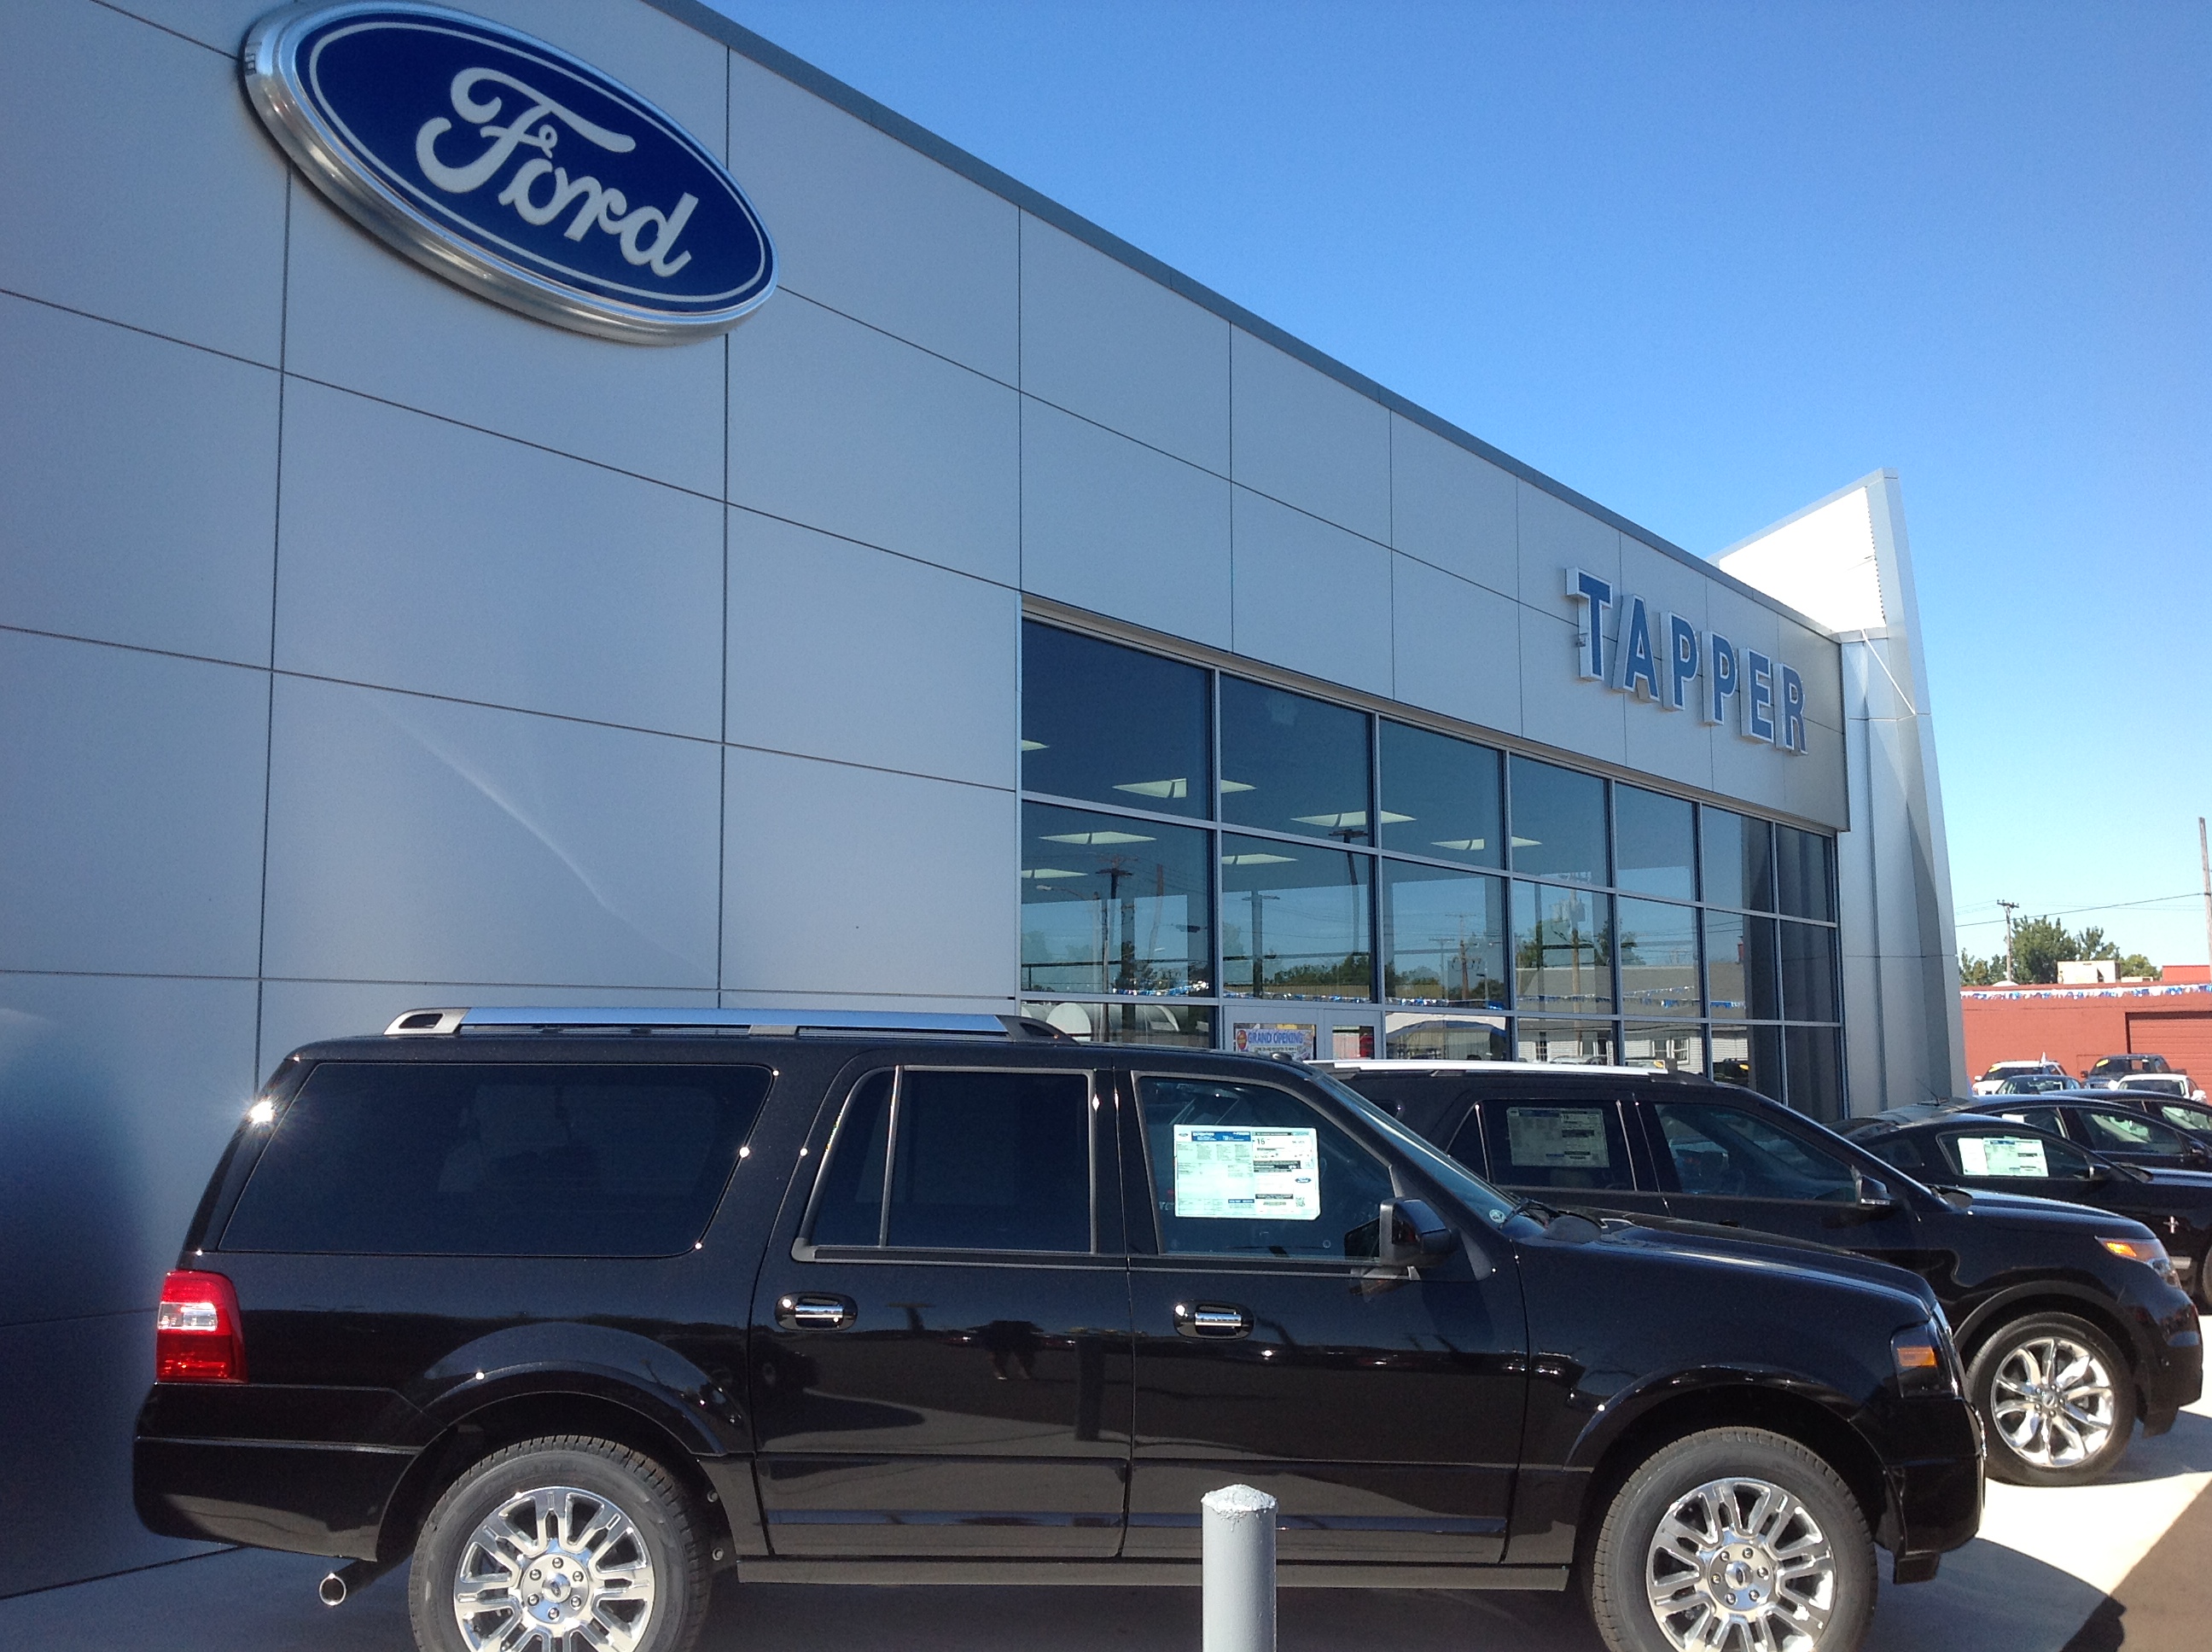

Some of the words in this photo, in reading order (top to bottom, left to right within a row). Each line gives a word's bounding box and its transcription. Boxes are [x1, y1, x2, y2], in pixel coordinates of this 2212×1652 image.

[416, 67, 699, 277] Ford
[1565, 567, 1807, 754] TAPPER
[1248, 1032, 1272, 1044] GRAND
[1273, 1032, 1303, 1044] OPENING
